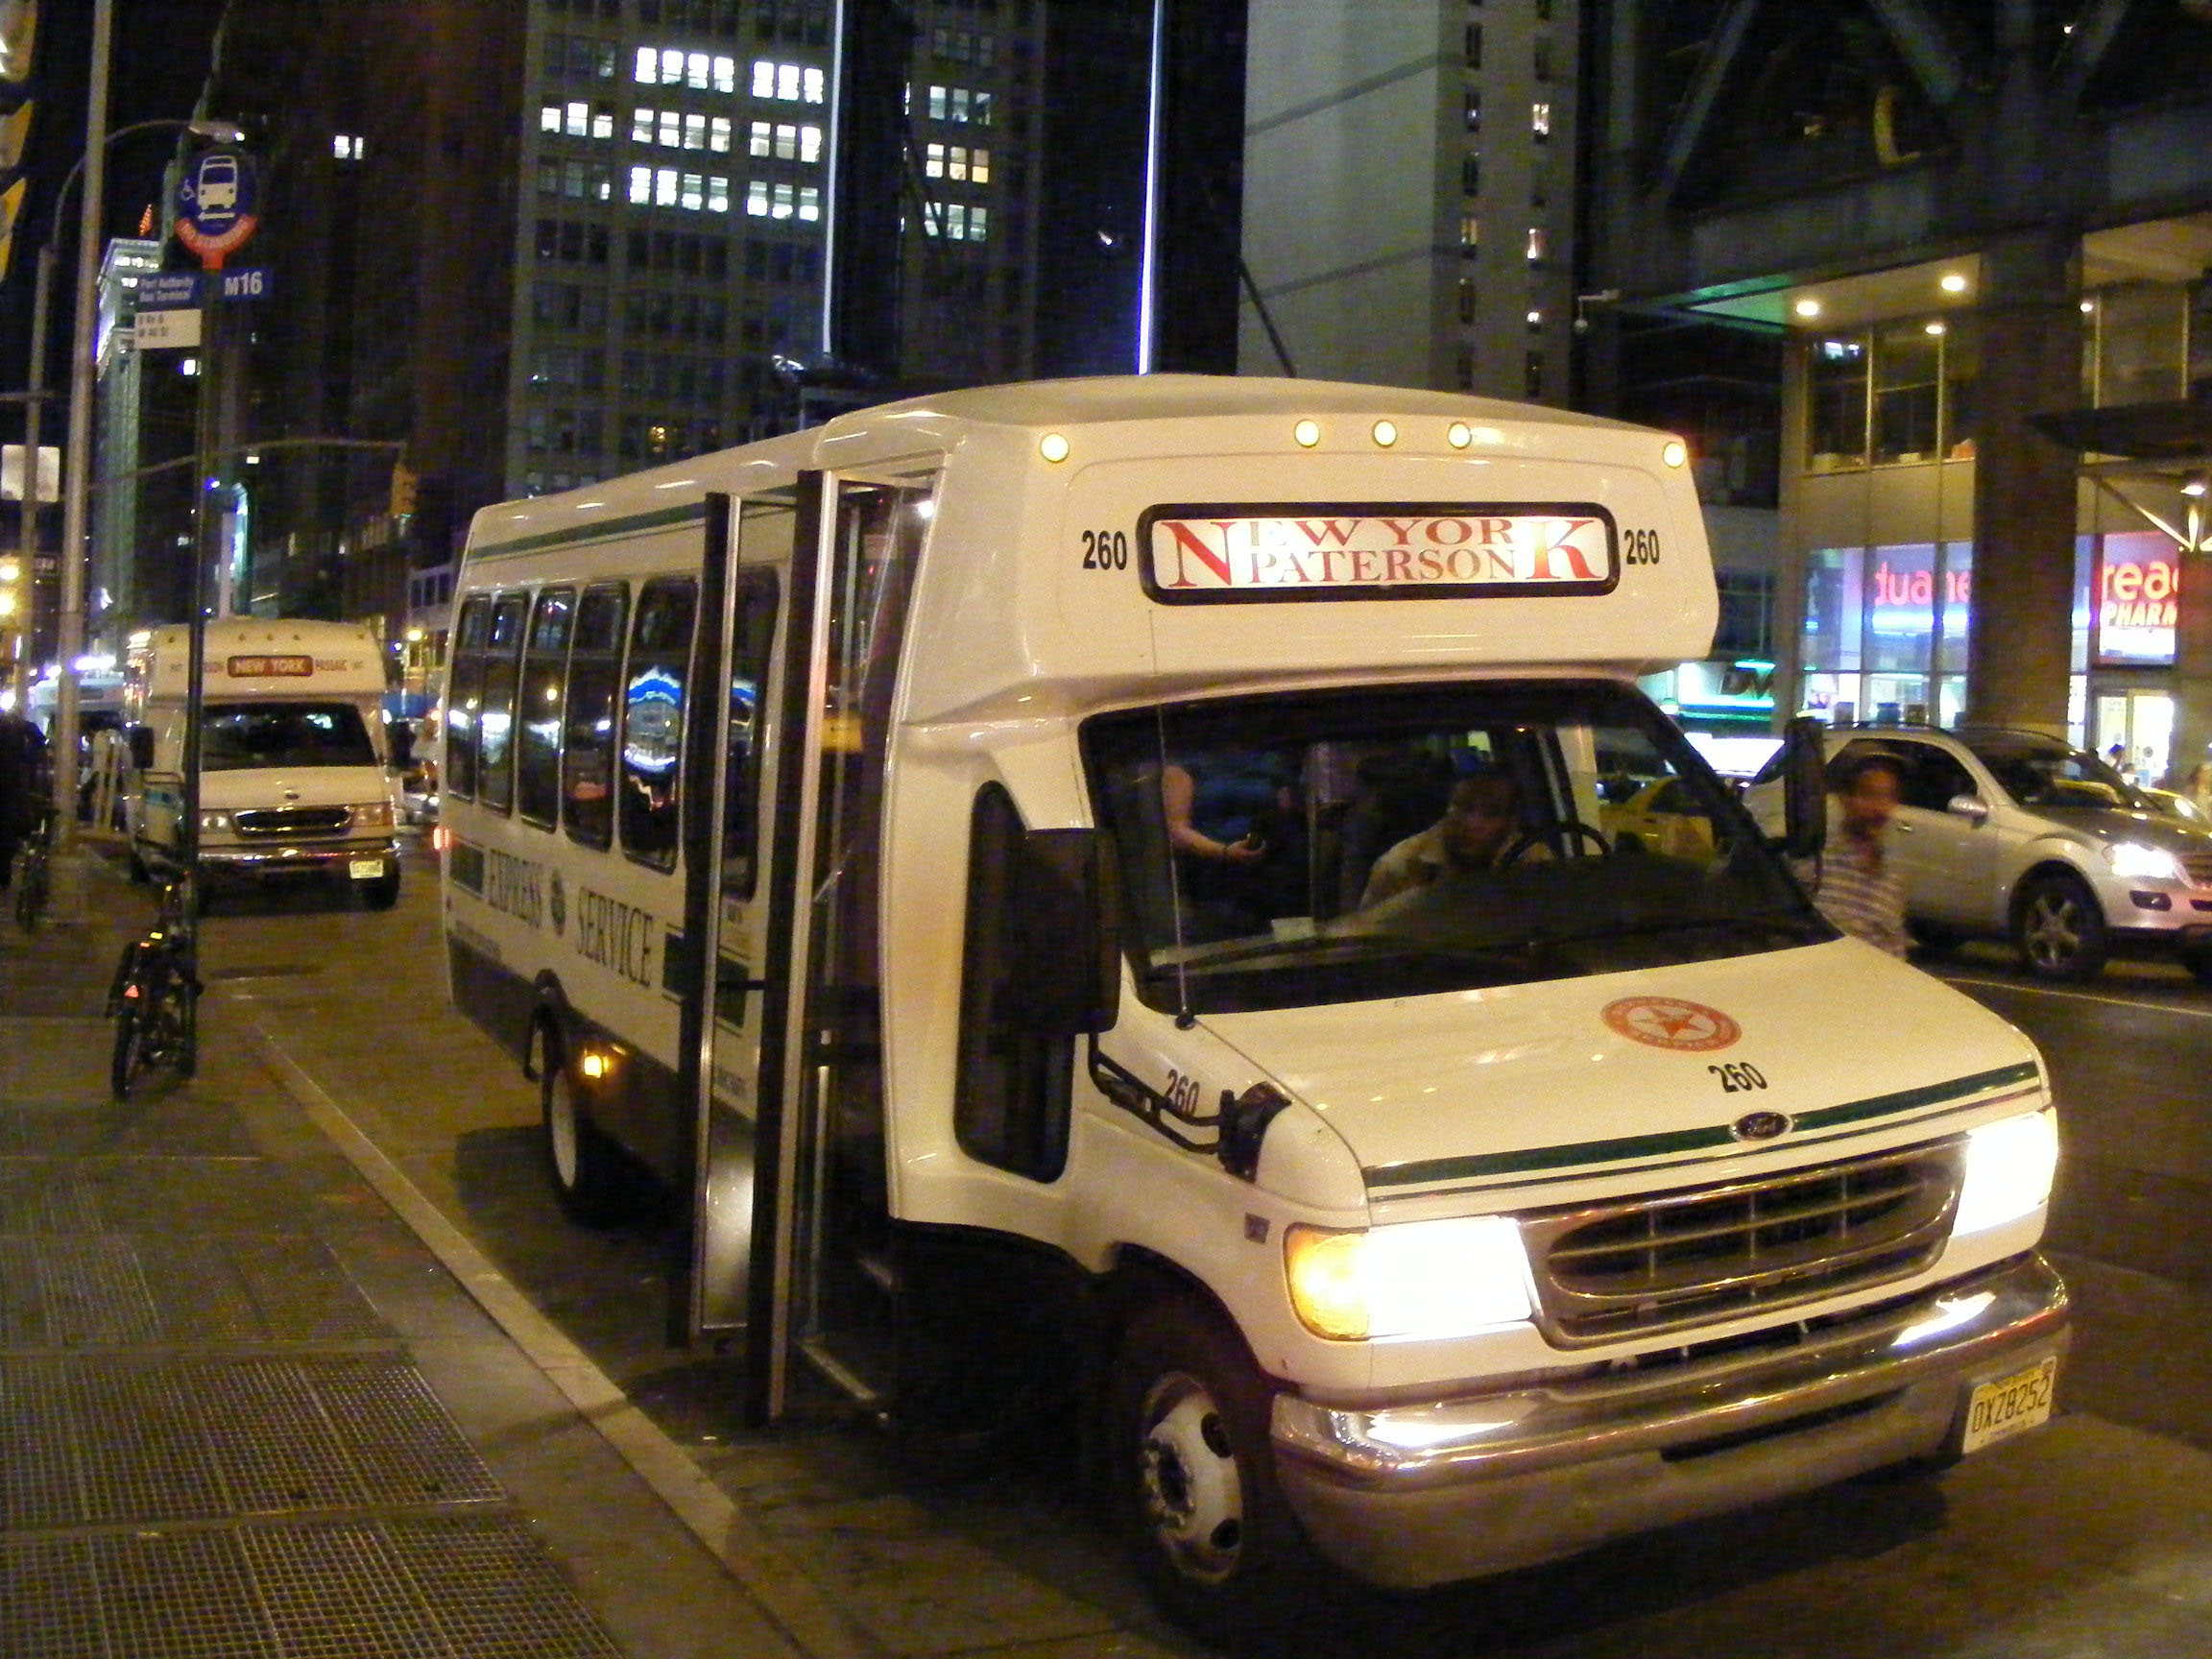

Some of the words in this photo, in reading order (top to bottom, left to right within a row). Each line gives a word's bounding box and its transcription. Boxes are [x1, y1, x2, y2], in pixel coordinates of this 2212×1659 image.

[224, 272, 263, 296] M16
[1081, 530, 1127, 570] 260
[1161, 519, 1364, 587] NEW
[1378, 518, 1602, 580] YORK
[1249, 548, 1516, 585] PATERSON
[1623, 529, 1660, 565] 260
[2102, 562, 2178, 601] rea
[577, 886, 654, 987] SERVICE
[1164, 1069, 1200, 1117] 260
[1708, 1062, 1767, 1093] 260
